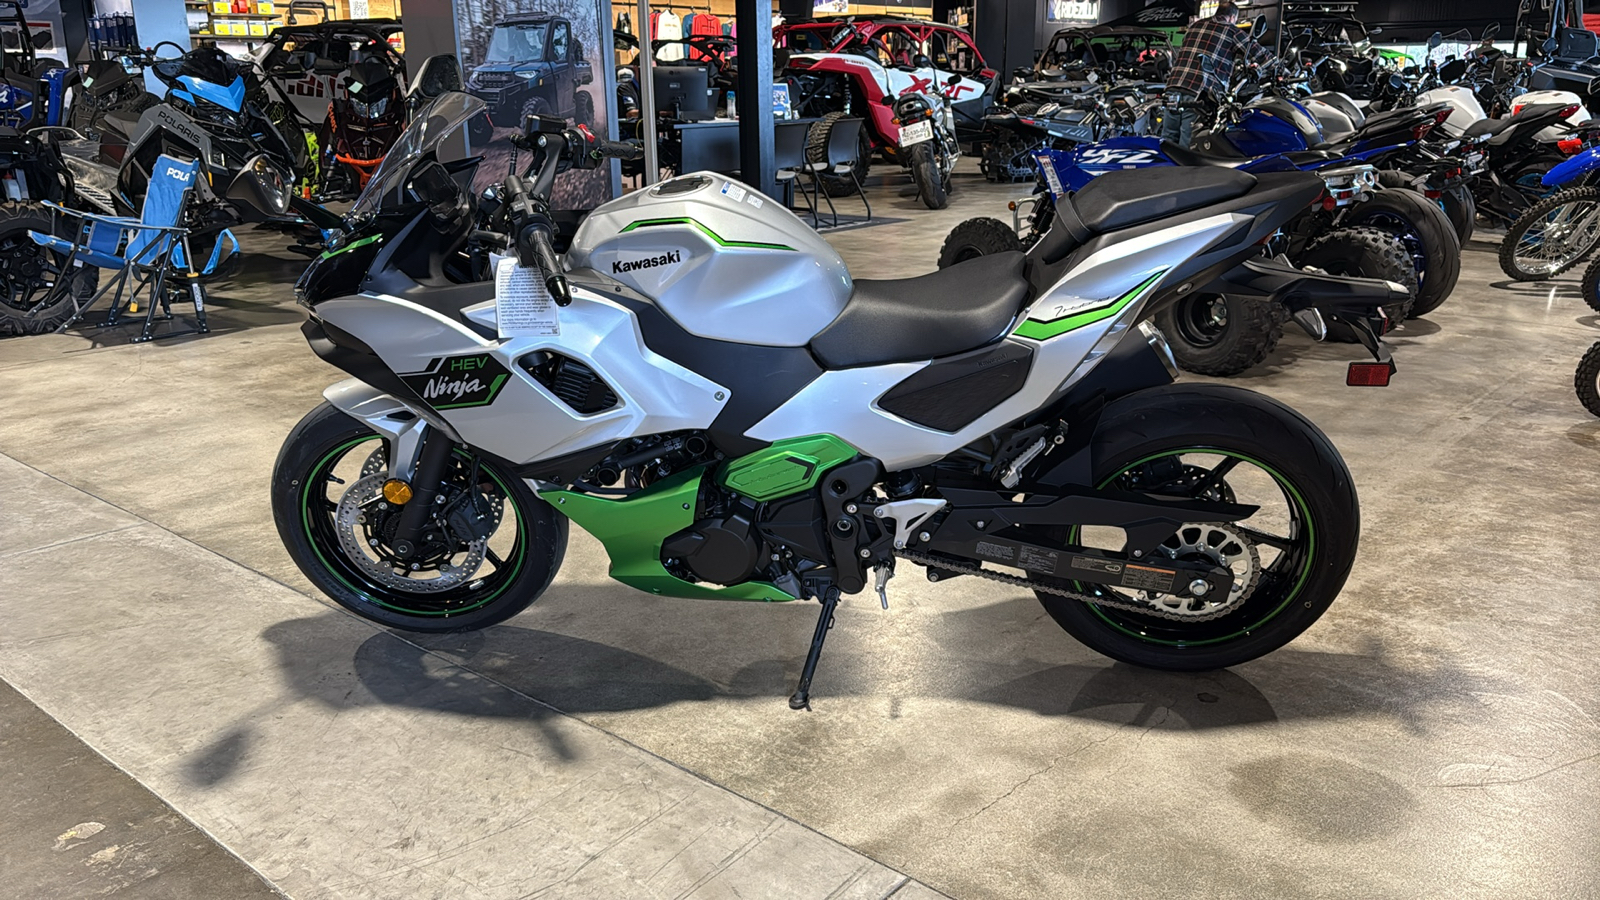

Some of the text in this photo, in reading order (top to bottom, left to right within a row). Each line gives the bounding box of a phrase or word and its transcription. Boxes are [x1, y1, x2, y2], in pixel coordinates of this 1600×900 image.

[158, 110, 201, 144] POLARIS
[1079, 149, 1159, 164] YFZ
[612, 250, 681, 274] Kawasaki
[450, 356, 489, 372] HEV
[423, 373, 487, 402] Ninja
